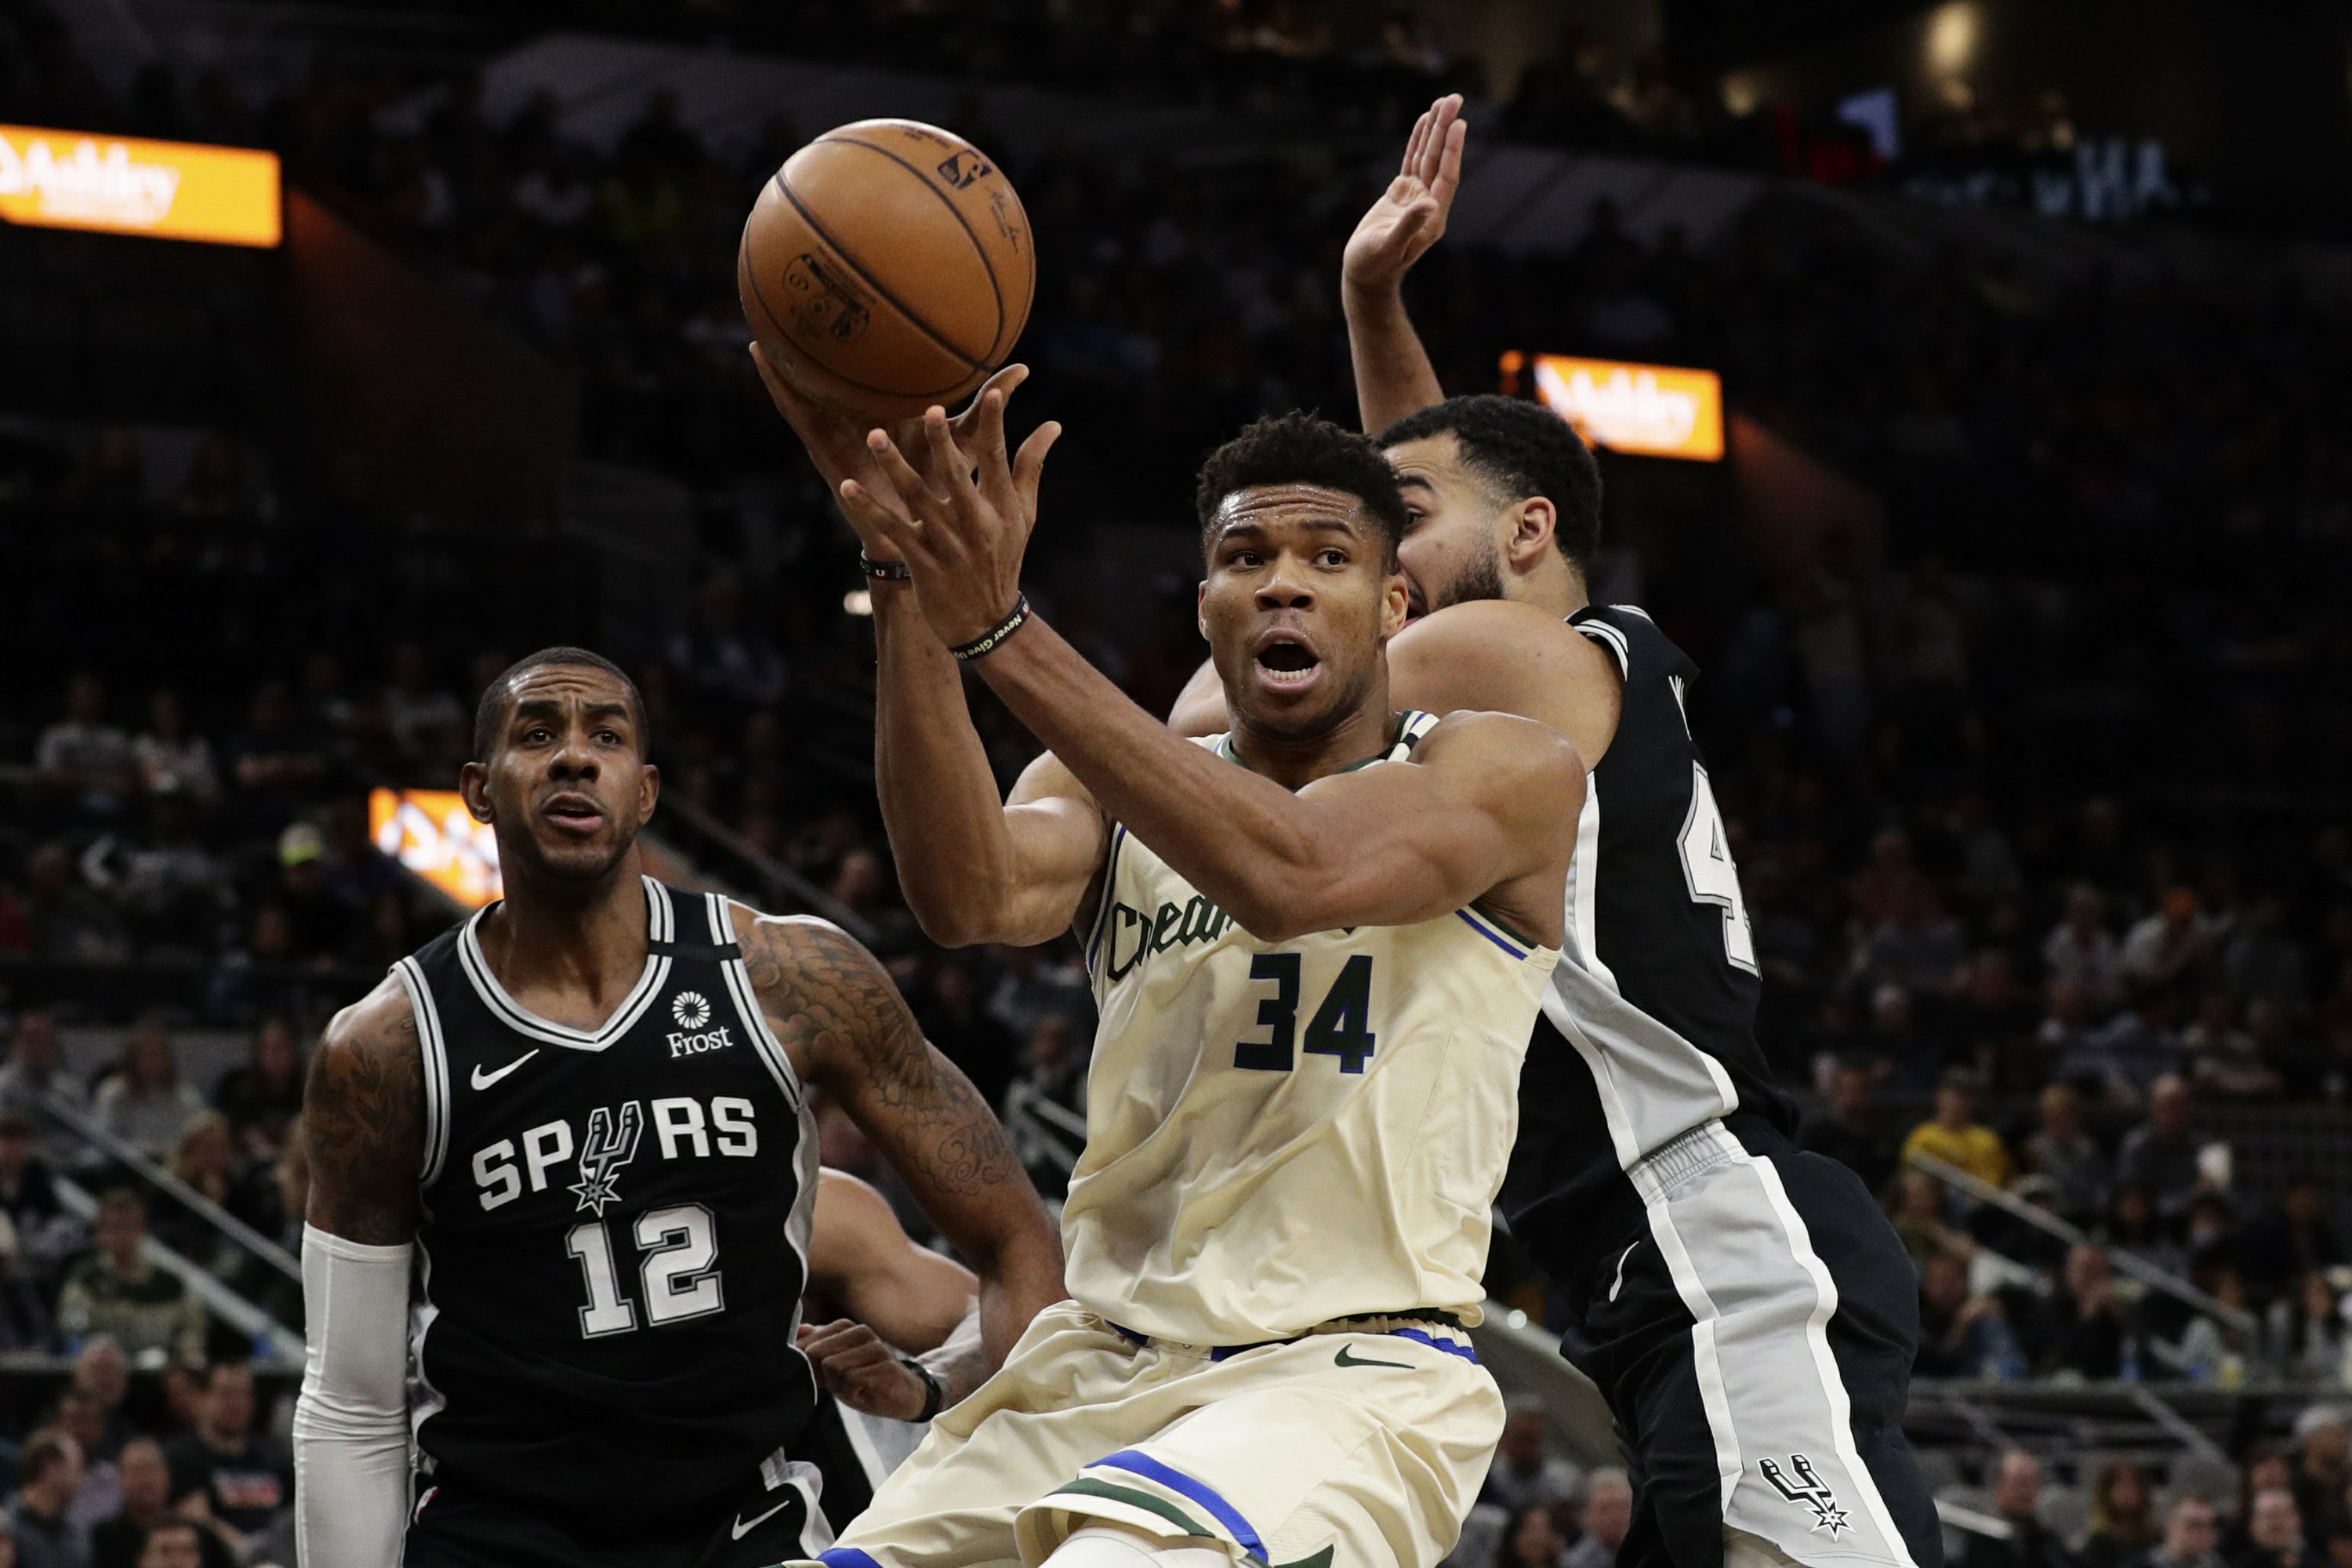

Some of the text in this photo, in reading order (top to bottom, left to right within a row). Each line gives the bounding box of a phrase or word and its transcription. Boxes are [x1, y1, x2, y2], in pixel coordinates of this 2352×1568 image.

[967, 639, 993, 655] Give
[994, 614, 1022, 641] Never
[666, 1025, 734, 1058] Frost
[1233, 953, 1376, 1075] 34
[472, 1096, 759, 1218] SPURS
[564, 1201, 726, 1340] 12
